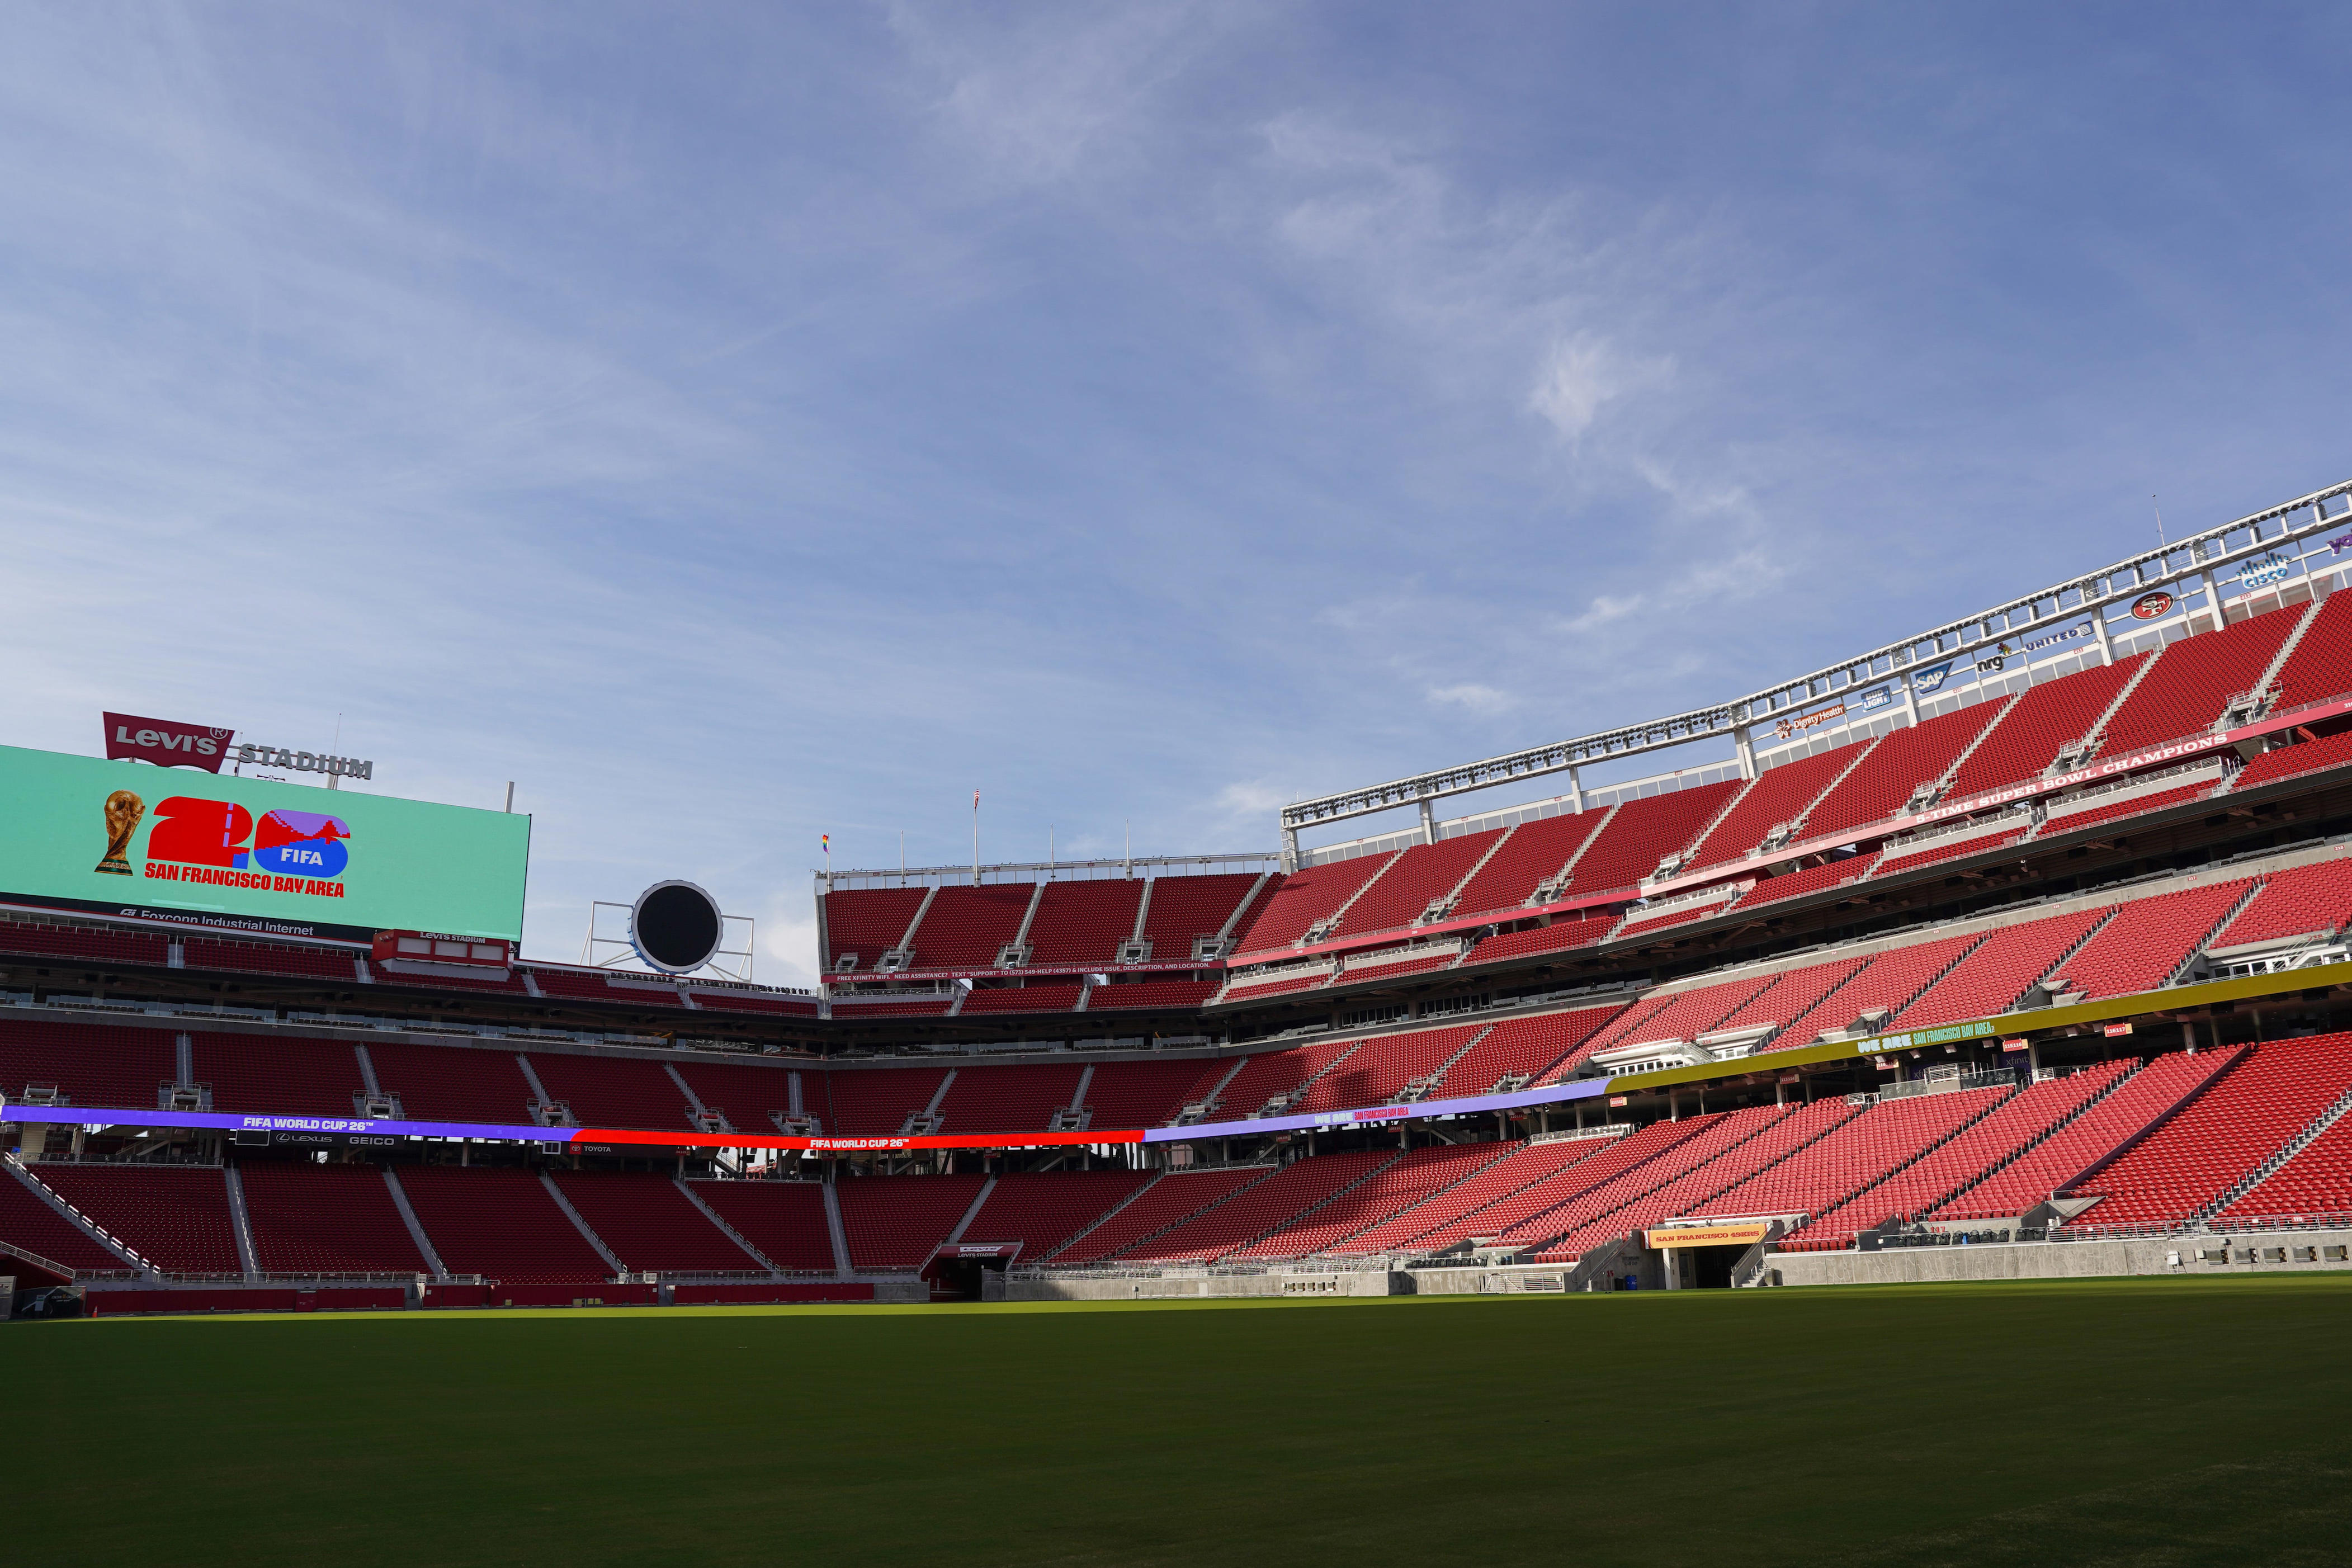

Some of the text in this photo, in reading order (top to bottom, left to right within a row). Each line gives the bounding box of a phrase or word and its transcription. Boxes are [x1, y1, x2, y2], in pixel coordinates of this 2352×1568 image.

[2327, 528, 2352, 554] ya
[2244, 568, 2287, 588] CISCO
[2025, 628, 2077, 651] UNITED
[1977, 657, 2003, 672] nrg
[1917, 670, 1944, 689] SAP
[1863, 696, 1888, 709] LIGHT
[1865, 689, 1883, 700] BUD
[1793, 705, 1844, 728] Dignity Health
[239, 743, 373, 780] STADIUM
[1916, 734, 2228, 823] 5-TIME SUPER BOWL CHAMPIONS
[280, 848, 323, 866] FIFA
[144, 862, 344, 898] SAN FRANCISCO BAY AREA
[141, 910, 198, 923] Foxconn
[202, 916, 262, 931] Industrial
[265, 922, 314, 936] Internet
[451, 935, 486, 943] STADIUM
[1857, 1038, 1881, 1054] WE
[1882, 1034, 1912, 1050] ARE
[1913, 1032, 1926, 1045] SAN
[1926, 1026, 1961, 1043] FRANCISCO
[1961, 1023, 1975, 1038] BAY
[2005, 1055, 2030, 1066] xfinity
[243, 1117, 272, 1127] FIFA
[274, 1118, 320, 1129] WORLD
[322, 1120, 348, 1130] CUP
[1315, 1114, 1331, 1125] WE
[1332, 1112, 1353, 1123] ARE
[1354, 1111, 1364, 1121] SAN
[1364, 1109, 1387, 1120] FRANCISCO
[1388, 1108, 1396, 1117] BAY
[349, 1136, 395, 1146] GEICO
[810, 1140, 830, 1148] FIFA
[832, 1140, 867, 1148] WORLD
[868, 1139, 889, 1147] CUP
[1677, 1232, 1728, 1241] FRANCISCO
